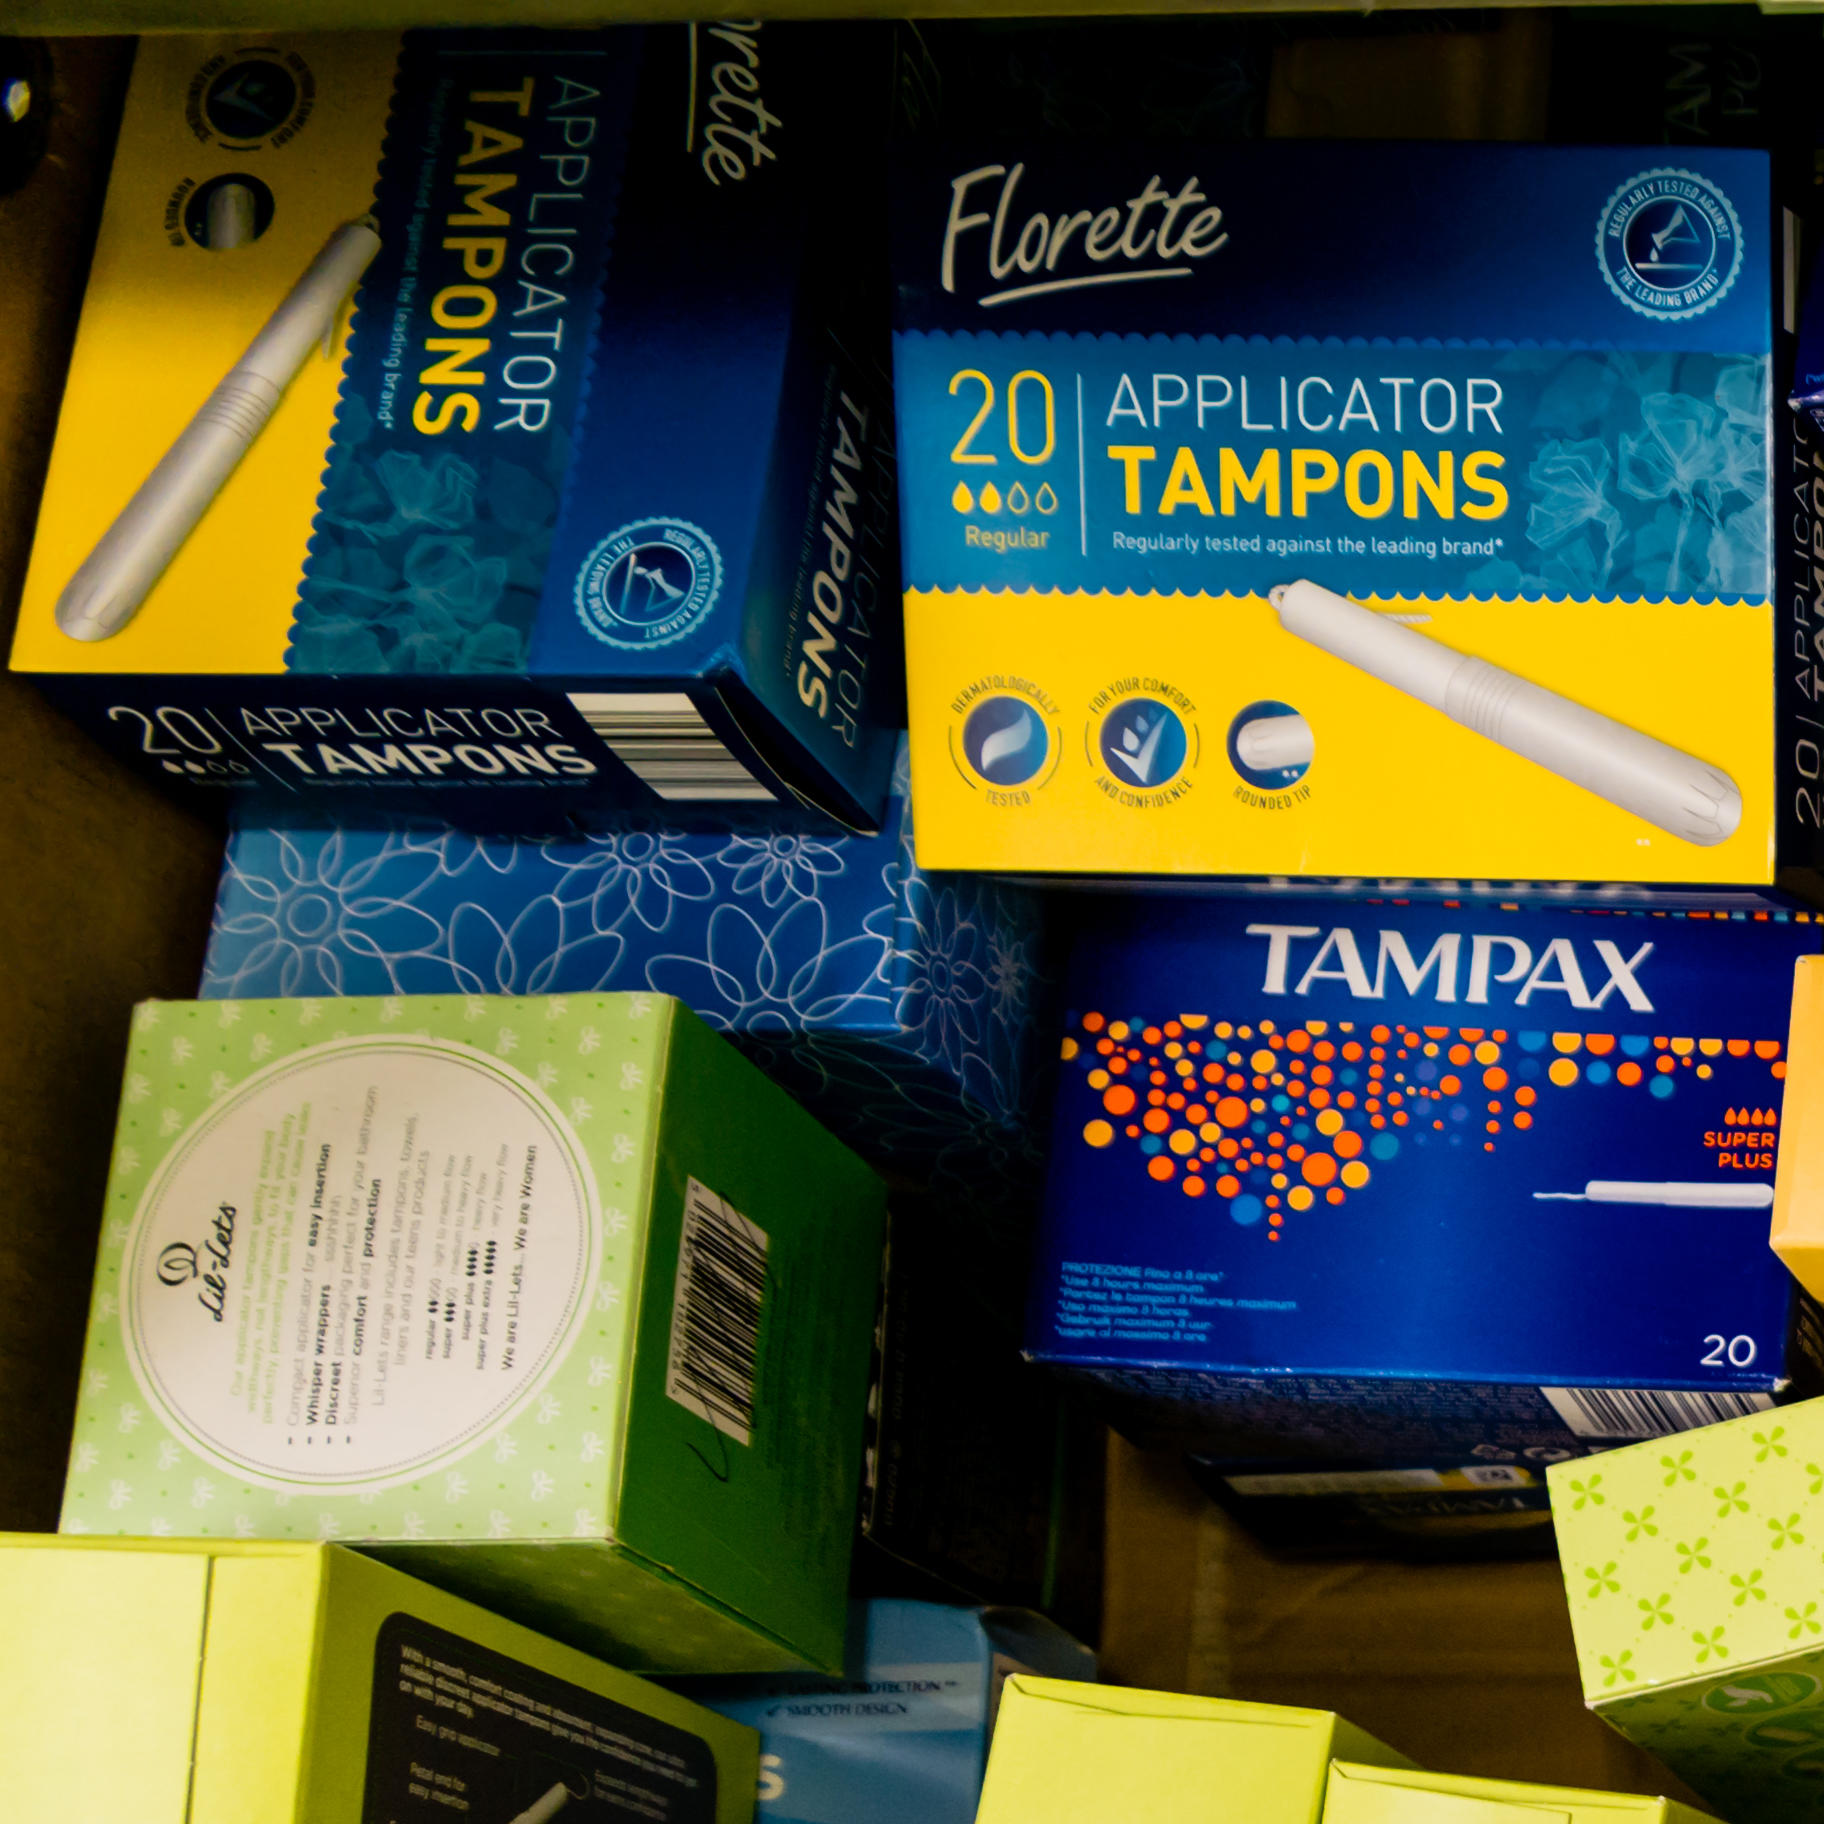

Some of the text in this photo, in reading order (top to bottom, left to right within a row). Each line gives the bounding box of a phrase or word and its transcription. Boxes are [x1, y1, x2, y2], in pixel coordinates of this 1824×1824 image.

[412, 75, 534, 436] TAMPONS
[493, 74, 601, 433] APPLICATOR
[941, 162, 1228, 295] Florette
[949, 370, 1503, 466] 20 APPLICATOR
[1107, 446, 1509, 520] TAMPONS
[798, 388, 872, 719] TAMPONS
[964, 524, 1050, 553] Regular
[1112, 531, 1200, 558] Regularly
[1204, 534, 1262, 555] tested
[1266, 534, 1330, 559] against
[1335, 533, 1365, 555] the
[1370, 534, 1436, 559] leading
[108, 704, 565, 757] 20 APPLICATOR
[262, 742, 599, 778] TAMPONS
[1246, 923, 1655, 1013] TAMPAX
[1703, 1130, 1776, 1150] SUPER
[1717, 1151, 1774, 1170] PLUS
[306, 1143, 332, 1247] easy insertion
[351, 1178, 383, 1356] comfort protection
[304, 1284, 333, 1426] Whisper wrappers
[325, 1361, 343, 1426] Discreet
[1700, 1334, 1758, 1370] 20
